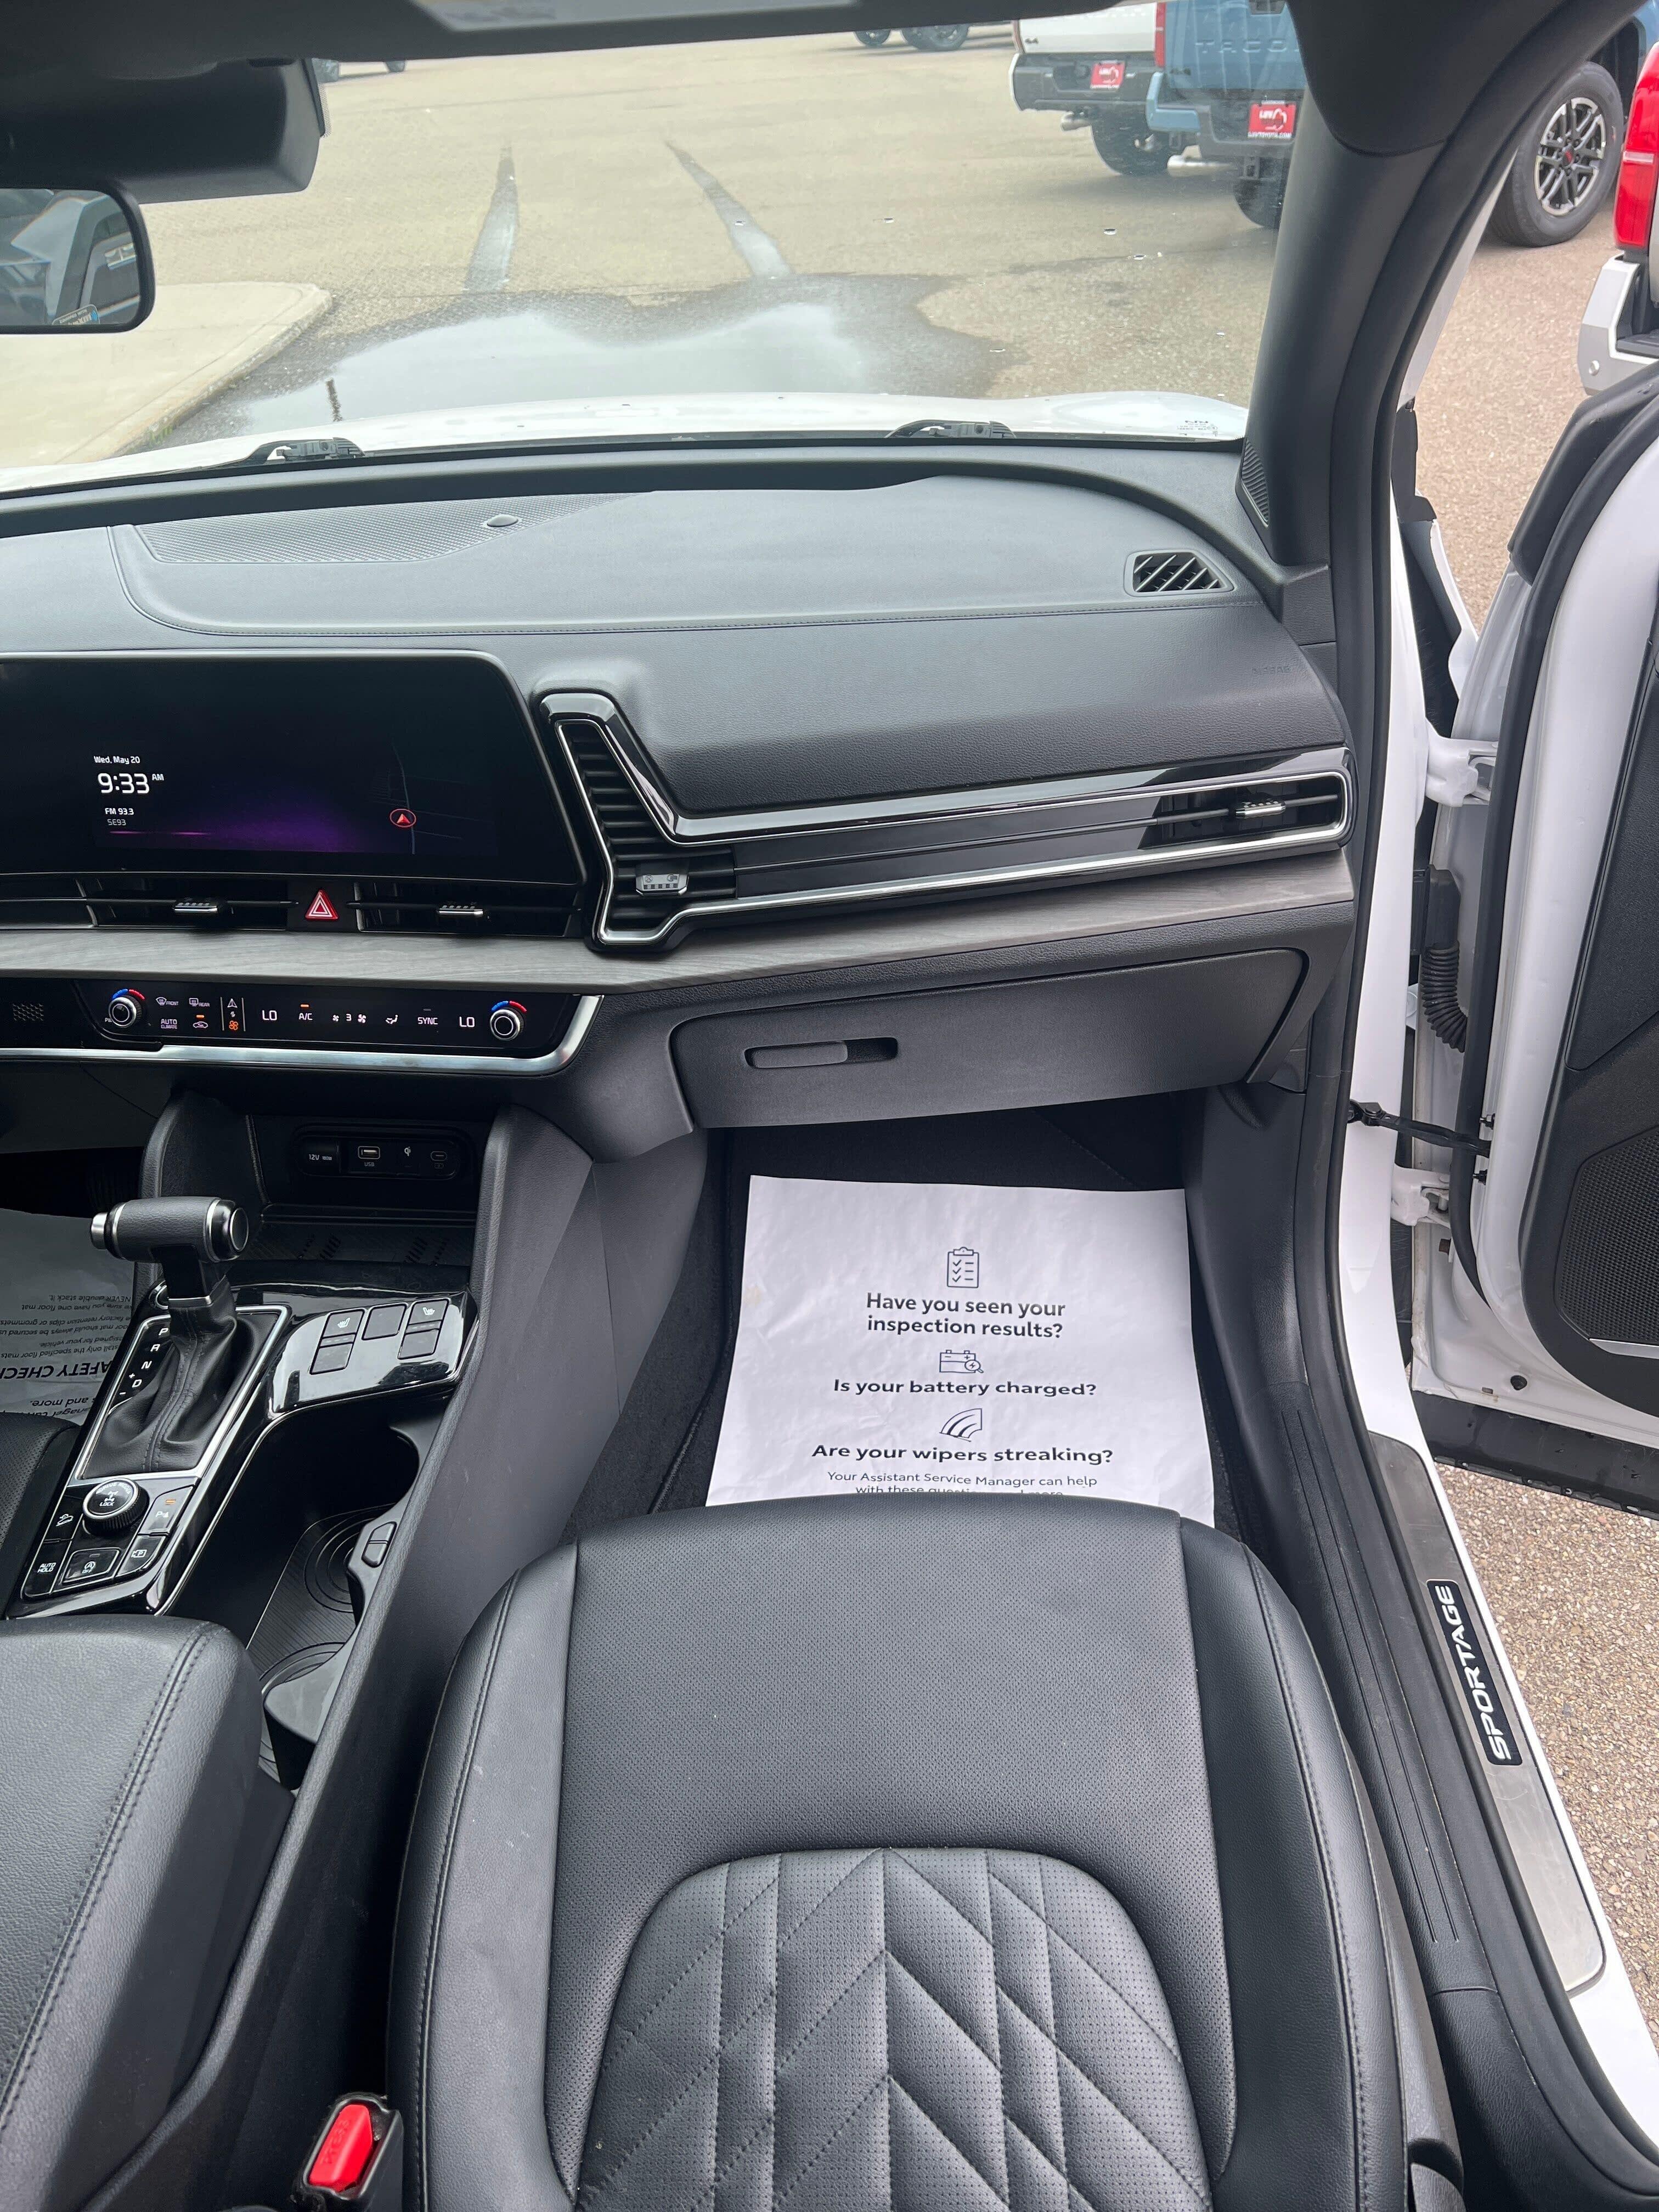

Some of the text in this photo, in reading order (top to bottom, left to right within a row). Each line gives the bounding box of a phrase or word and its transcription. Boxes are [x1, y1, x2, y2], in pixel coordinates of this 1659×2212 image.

[1195, 40, 1300, 53] TACO
[113, 756, 129, 765] May
[98, 773, 150, 793] 9:33
[262, 1010, 278, 1021] LO
[298, 1012, 313, 1021] A/C
[346, 1013, 352, 1022] 3
[417, 1017, 438, 1025] SYNC
[459, 1016, 475, 1028] LO
[866, 1292, 1066, 1318] Have you seen your
[158, 1328, 169, 1336] P
[867, 1315, 1063, 1338] inspection results?
[40, 1348, 71, 1357] specified
[150, 1344, 161, 1352] R
[57, 1361, 112, 1376] AFETY
[141, 1361, 152, 1369] N
[132, 1379, 142, 1388] D
[834, 1379, 1097, 1397] Is your battery charged?
[66, 1397, 88, 1406] and
[812, 1444, 1113, 1465] Are your wipers streaking?
[827, 1471, 857, 1481] Your
[860, 1472, 920, 1482] Assistant
[924, 1474, 972, 1484] Service
[976, 1476, 1035, 1487] Manager
[1067, 1476, 1097, 1487] help
[1435, 1585, 1511, 1760] SPORTAGE
